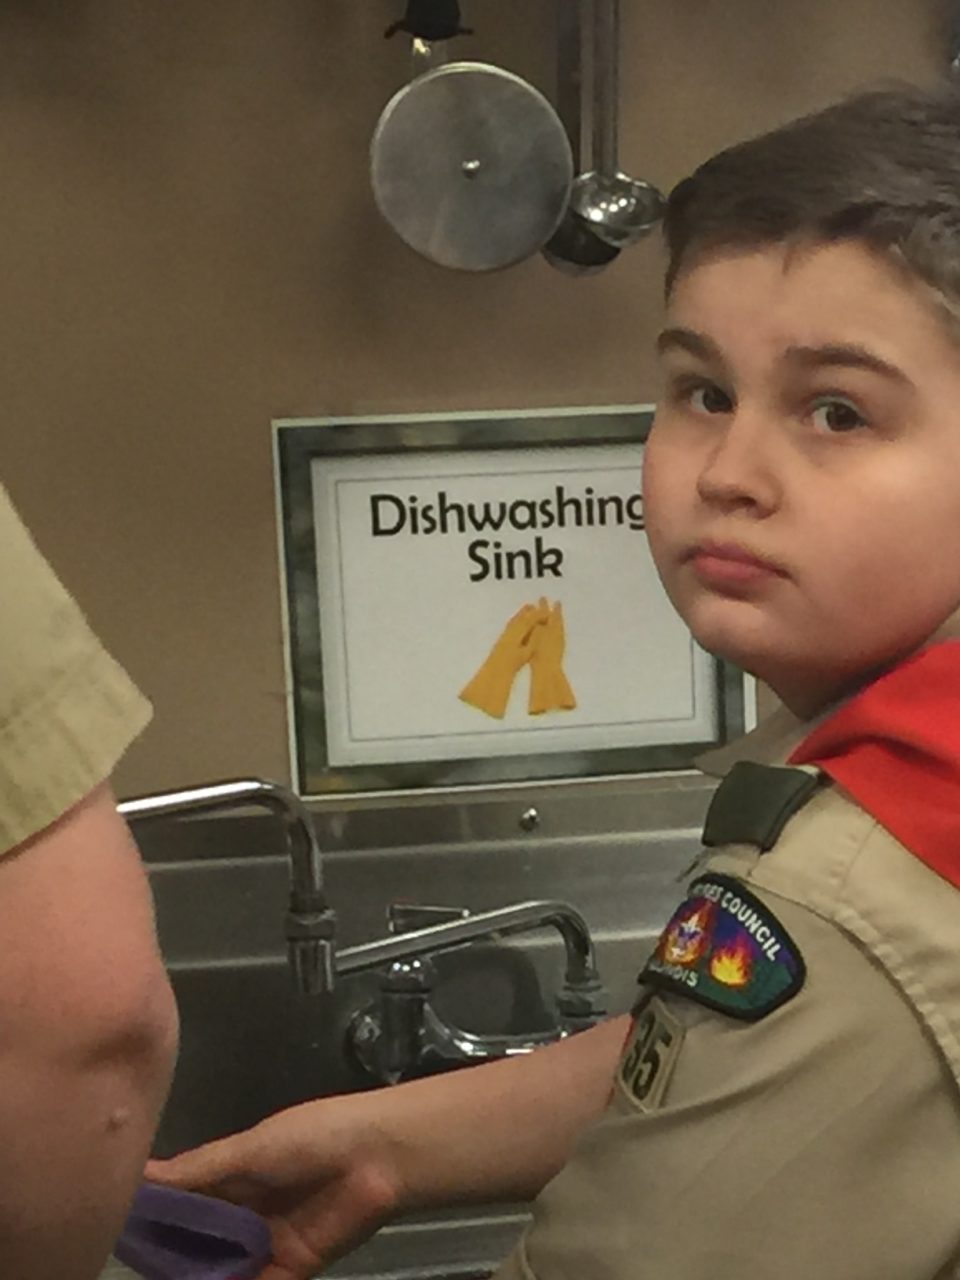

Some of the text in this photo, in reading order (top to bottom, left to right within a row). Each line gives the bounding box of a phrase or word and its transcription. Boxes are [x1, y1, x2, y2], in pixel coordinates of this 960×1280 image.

[370, 485, 645, 537] Dishwashing
[467, 536, 564, 582] Sink
[721, 890, 782, 962] COUNCIL
